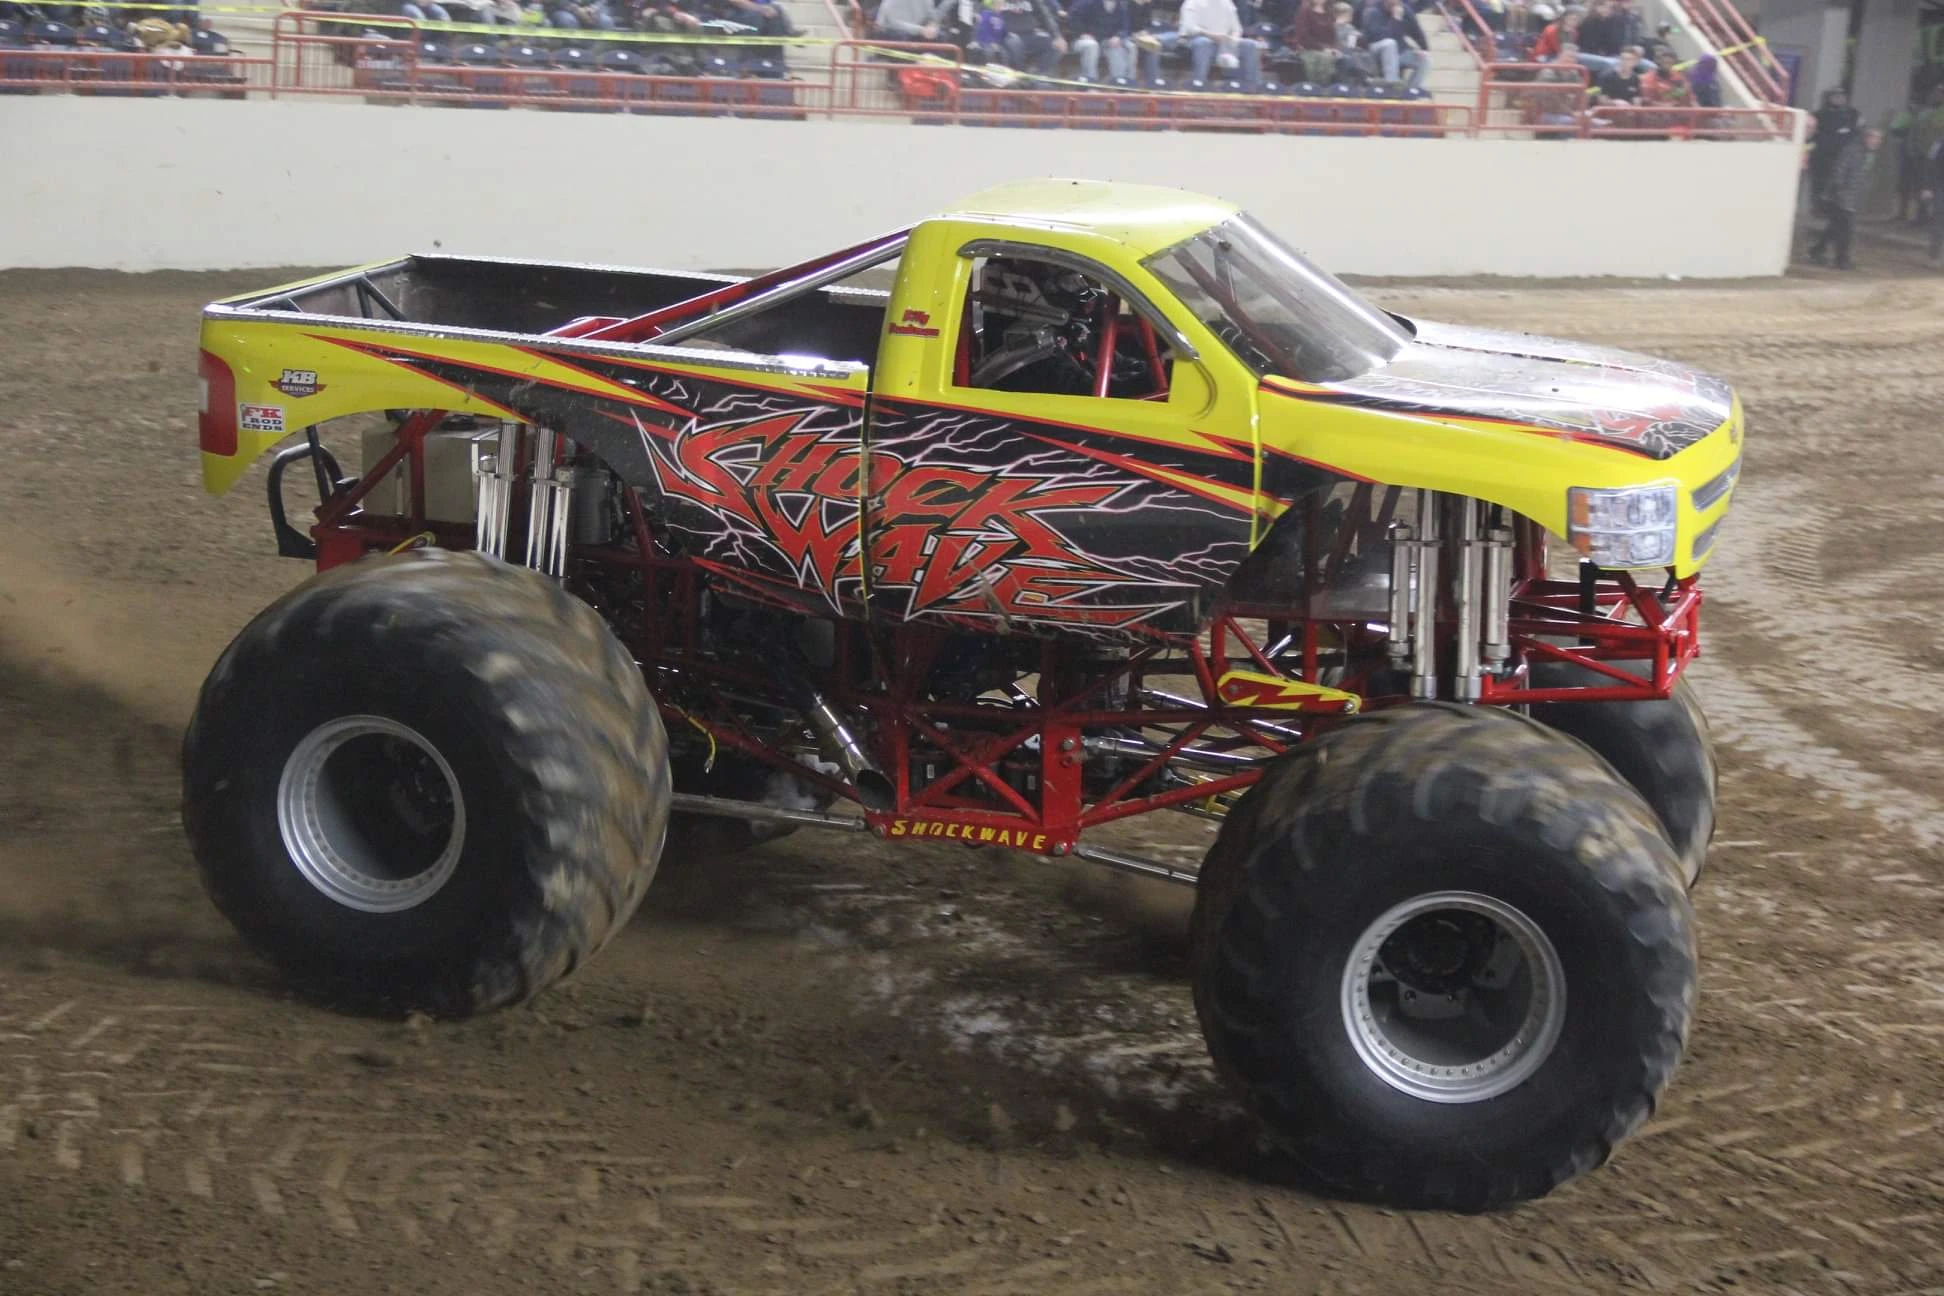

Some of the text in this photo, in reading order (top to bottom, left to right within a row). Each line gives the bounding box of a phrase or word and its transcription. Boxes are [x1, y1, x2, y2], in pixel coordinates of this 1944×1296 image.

[242, 423, 283, 431] ENDS
[244, 406, 281, 419] FK
[652, 412, 1130, 555] SHOCK
[754, 485, 1170, 625] WAVE
[891, 819, 1047, 850] SHOCKWAVE
